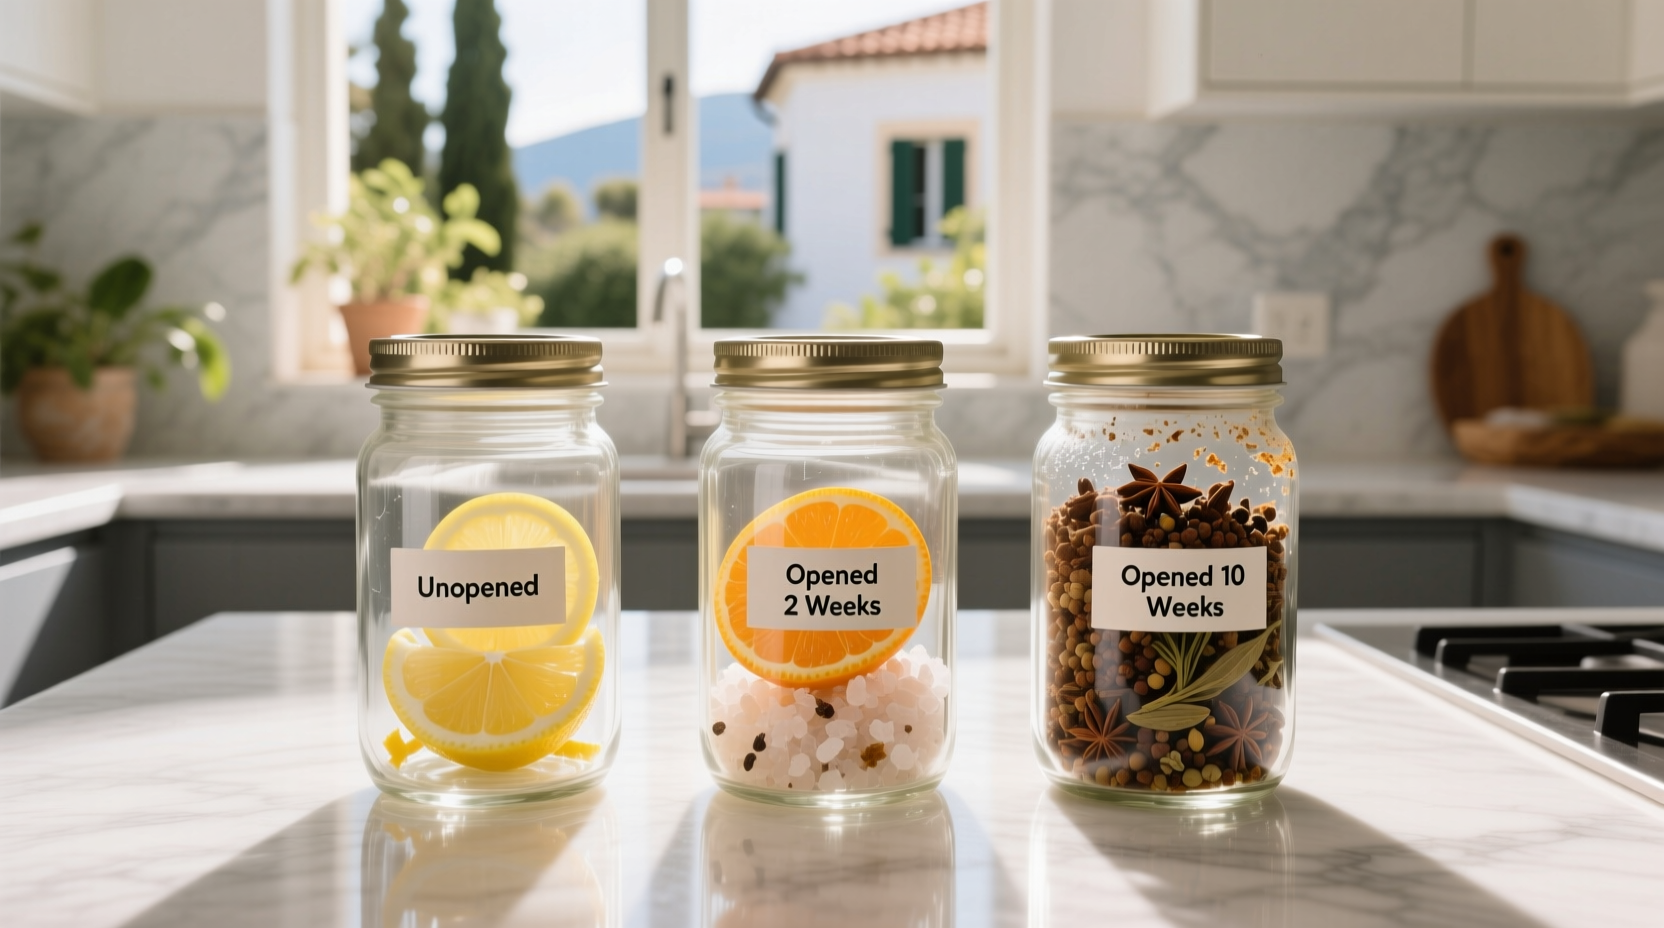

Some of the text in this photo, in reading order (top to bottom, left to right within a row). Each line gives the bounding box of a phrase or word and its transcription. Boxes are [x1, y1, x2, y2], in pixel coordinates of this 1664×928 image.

[417, 573, 539, 604] Unopened
[786, 562, 878, 592] Opened
[1121, 563, 1245, 593] Opened 10
[783, 593, 882, 617] 2 Weeks
[1146, 594, 1224, 618] Weeks
